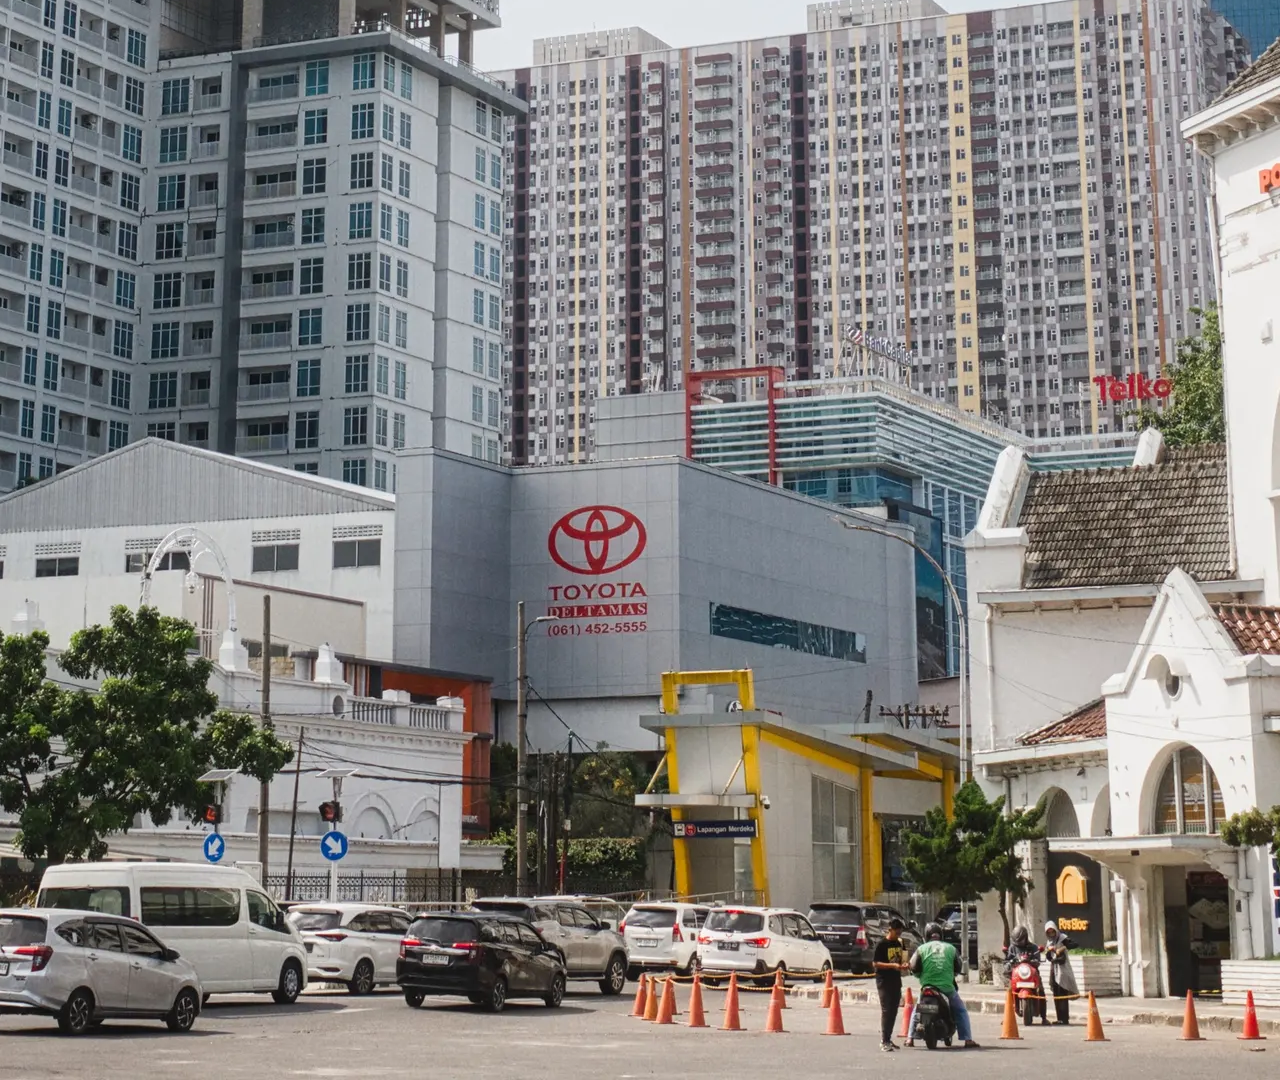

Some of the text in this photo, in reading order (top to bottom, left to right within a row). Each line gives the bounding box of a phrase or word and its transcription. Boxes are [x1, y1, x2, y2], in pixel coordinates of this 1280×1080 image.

[548, 582, 647, 601] TOYOTA
[548, 603, 647, 618] DELTAMAS
[547, 621, 647, 637] (061) 452-5555
[697, 826, 726, 834] Lapangan
